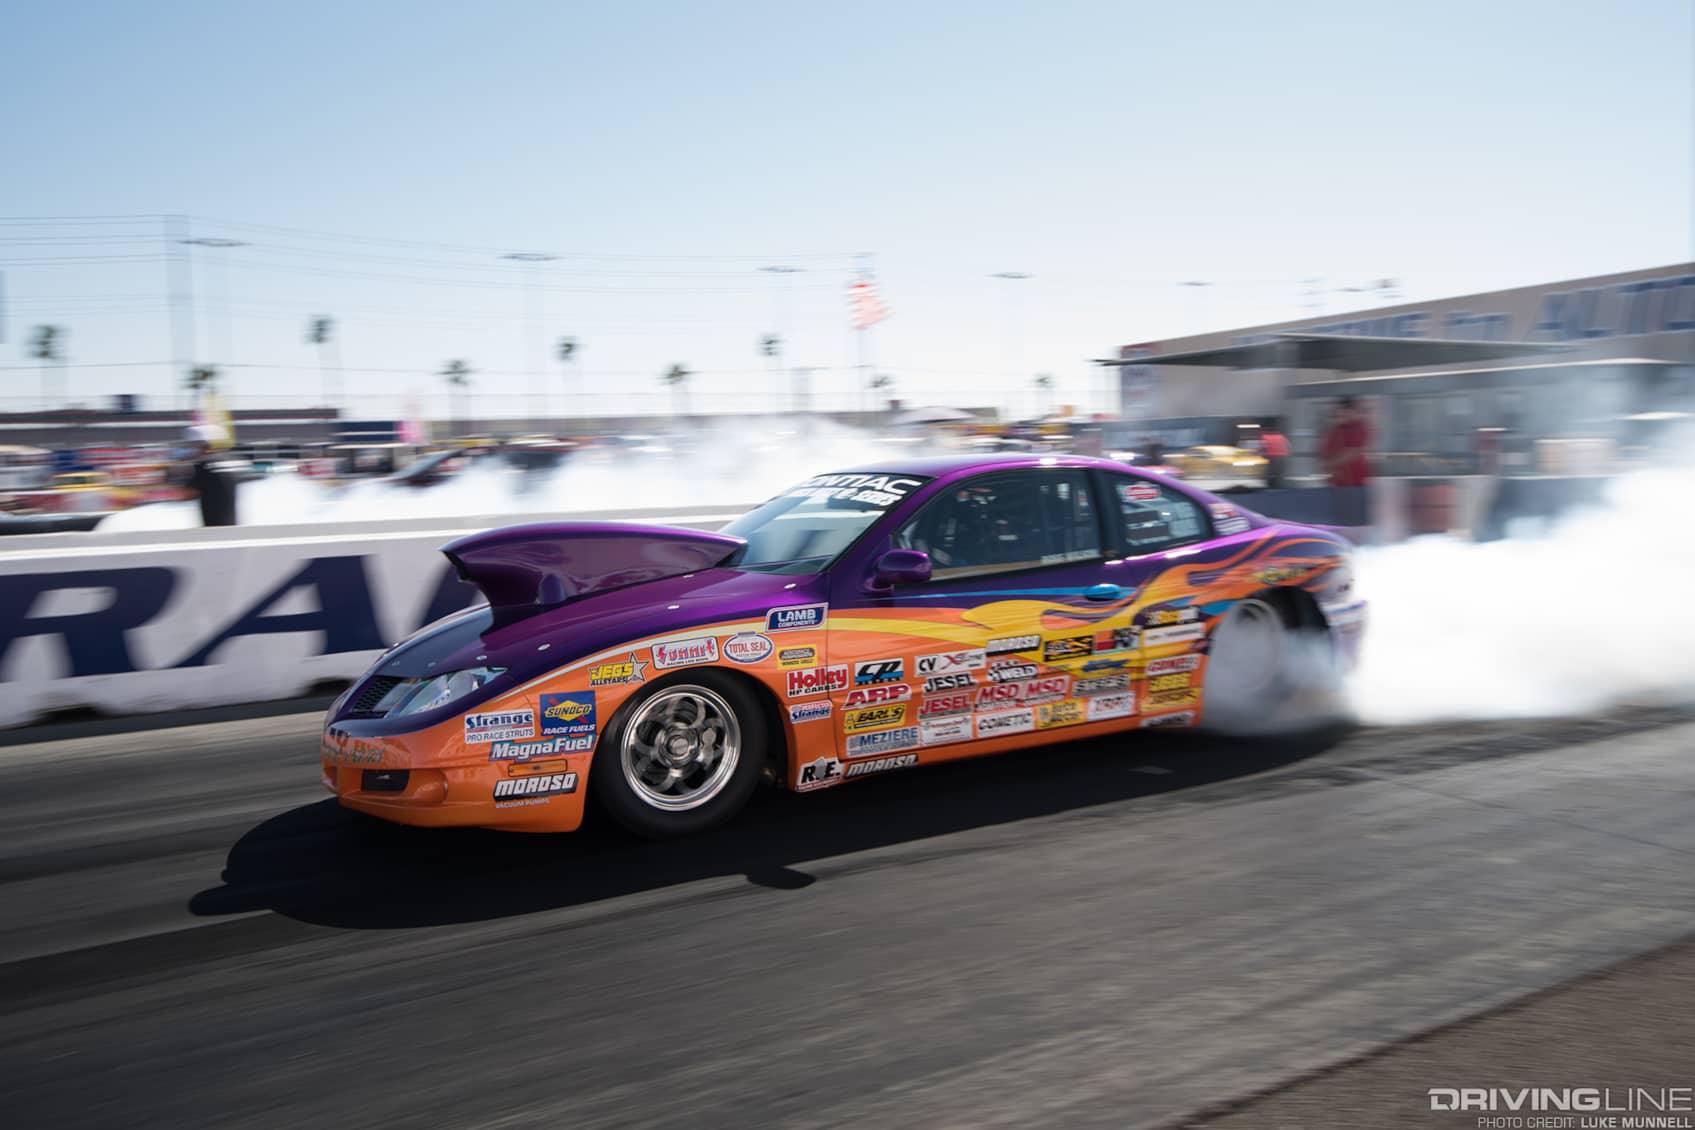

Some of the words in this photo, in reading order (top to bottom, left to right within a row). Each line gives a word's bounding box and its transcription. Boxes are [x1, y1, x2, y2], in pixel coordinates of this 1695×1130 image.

[778, 609, 816, 622] LAMB
[728, 643, 750, 654] TOTAL
[751, 641, 768, 652] SEAL
[591, 662, 634, 680] JEGS
[919, 658, 936, 672] CV
[788, 668, 848, 691] Holley
[925, 673, 977, 693] JESEL
[789, 688, 801, 697] HP
[846, 686, 909, 706] ARP
[981, 683, 1019, 701] MSD
[1026, 678, 1065, 695] MSD
[546, 702, 592, 718] SUNOCO
[920, 695, 972, 714] JESEL
[466, 711, 534, 731] Strange
[543, 726, 568, 735] RACE
[569, 724, 596, 734] FUELS
[467, 733, 482, 743] PRO
[483, 730, 504, 741] RACE
[505, 728, 534, 740] STRUTS
[859, 727, 919, 747] MEZIERE
[492, 735, 593, 760] MagnaFuel
[495, 773, 577, 797] MOROSO
